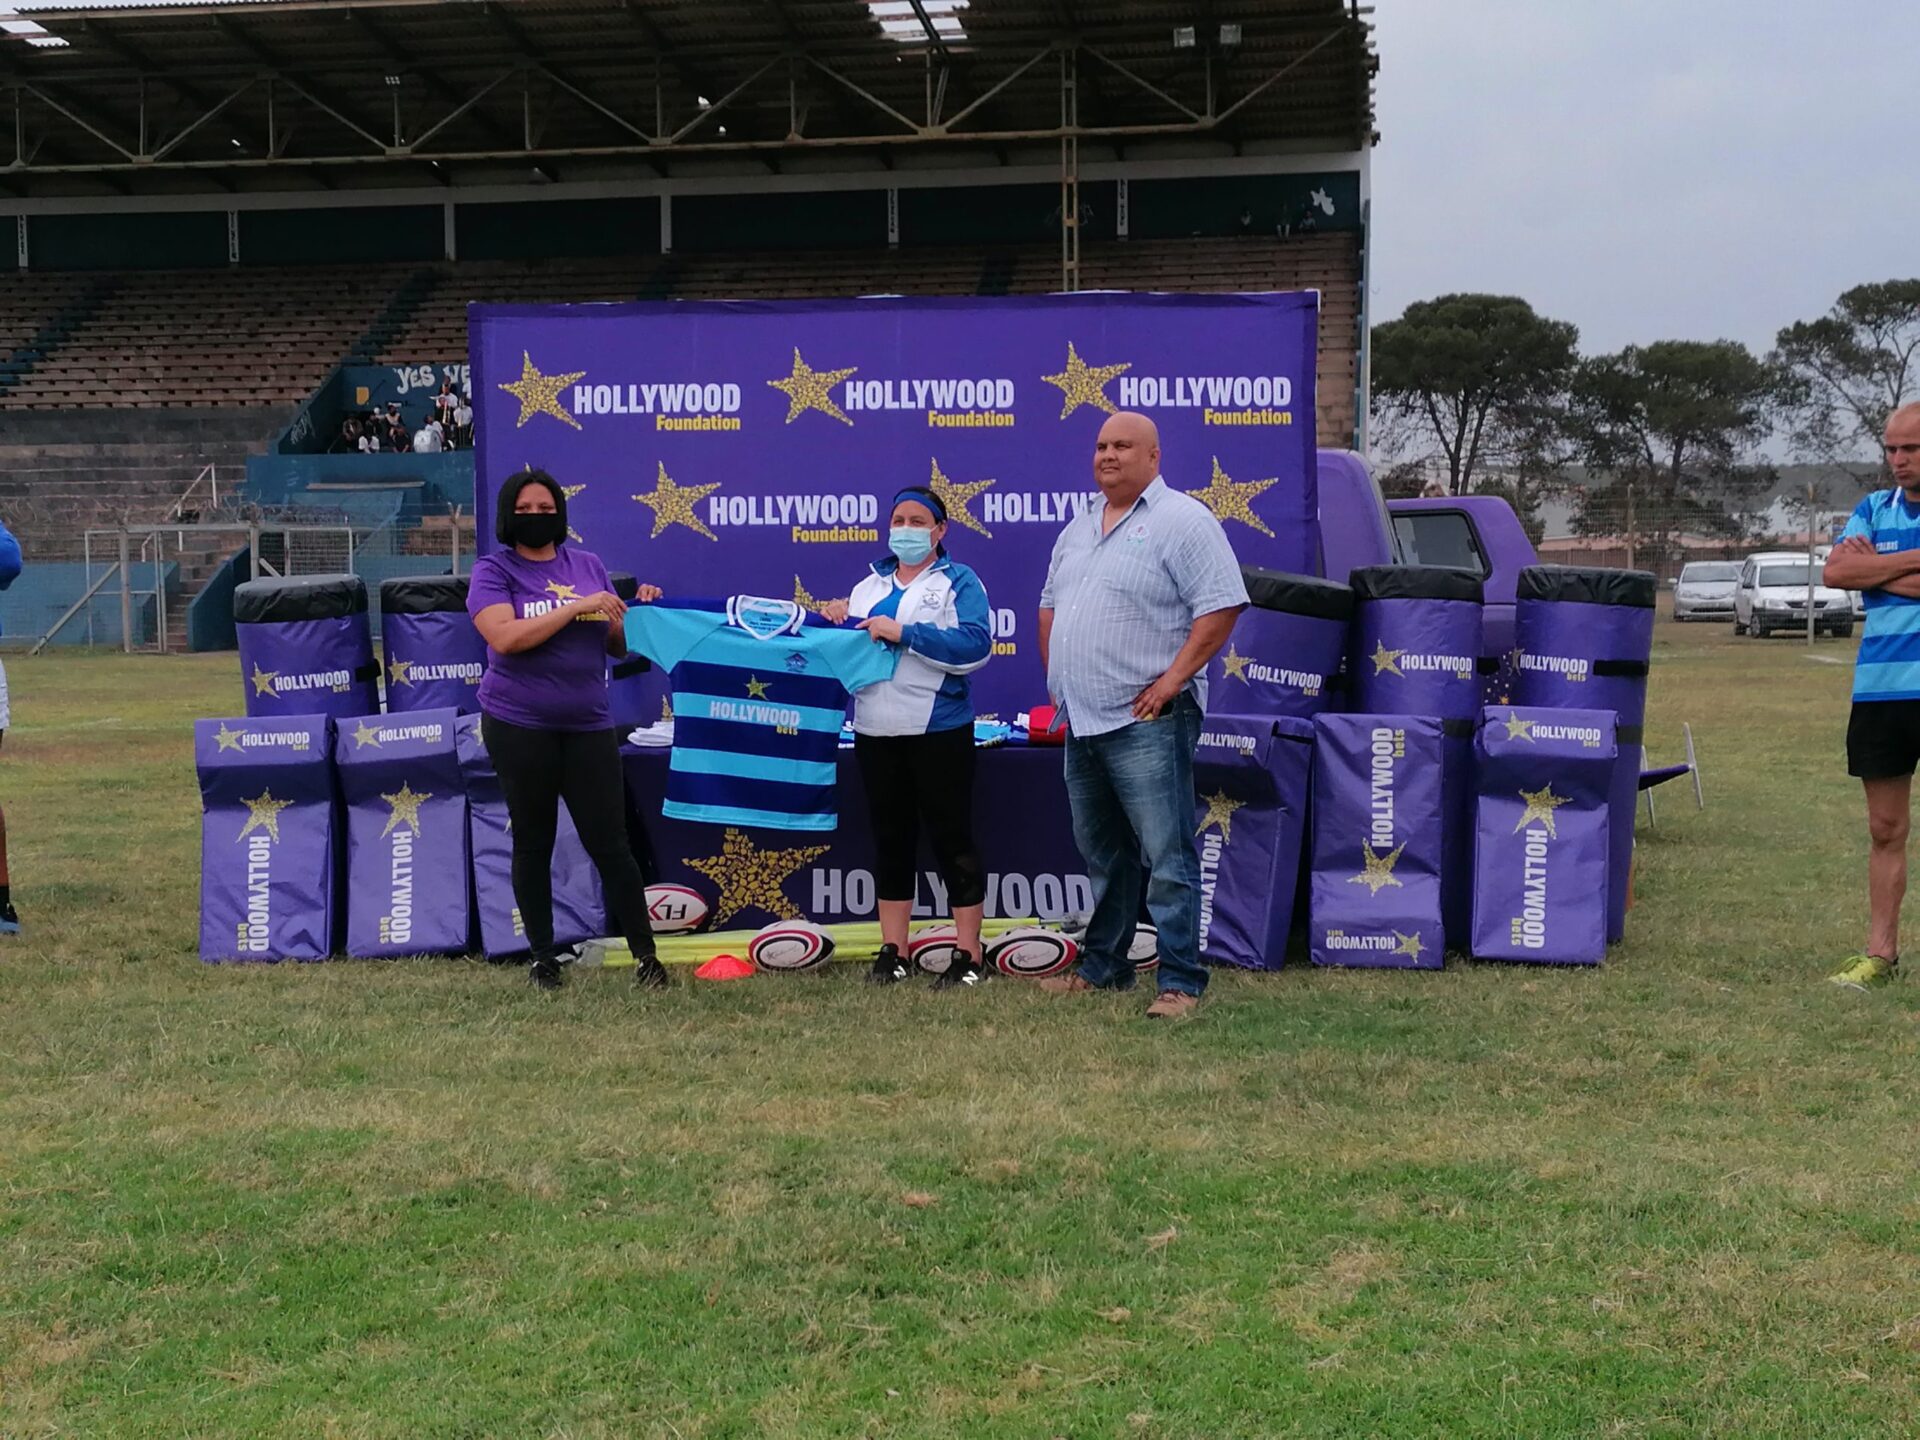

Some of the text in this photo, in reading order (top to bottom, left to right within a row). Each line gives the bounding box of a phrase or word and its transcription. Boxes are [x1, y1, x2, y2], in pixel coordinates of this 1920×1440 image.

[574, 384, 741, 414] HOLLYWOOD
[845, 379, 1014, 410] HOLLYWOOD
[1120, 376, 1292, 408] HOLLYWOOD
[656, 414, 741, 432] Foundation
[928, 410, 1014, 428] Foundation
[1204, 408, 1292, 426] Foundation
[710, 495, 878, 526] HOLLYWOOD
[792, 527, 878, 544] Foundation
[409, 662, 482, 681] HOLLYWOOD
[1401, 654, 1472, 672] HOLLYWOOD
[1520, 654, 1588, 674] HOLLYWOOD
[274, 670, 350, 692] HOLLYWOOD
[1248, 664, 1322, 689] HOLLYWOOD
[710, 701, 800, 727] HOLLYWOOD
[242, 732, 310, 746] HOLLYWOOD
[379, 724, 442, 742] HOLLYWOOD
[1532, 725, 1601, 742] HOLLYWOOD
[1372, 728, 1394, 848] HOLLYWOOD
[248, 836, 270, 952] HOLLYWOOD
[390, 830, 413, 944] HOLLYWOOD
[812, 868, 1096, 921] HOLYOOD
[1522, 829, 1548, 948] HOLLYWOOD
[1326, 936, 1396, 950] HOLLYWOOD
